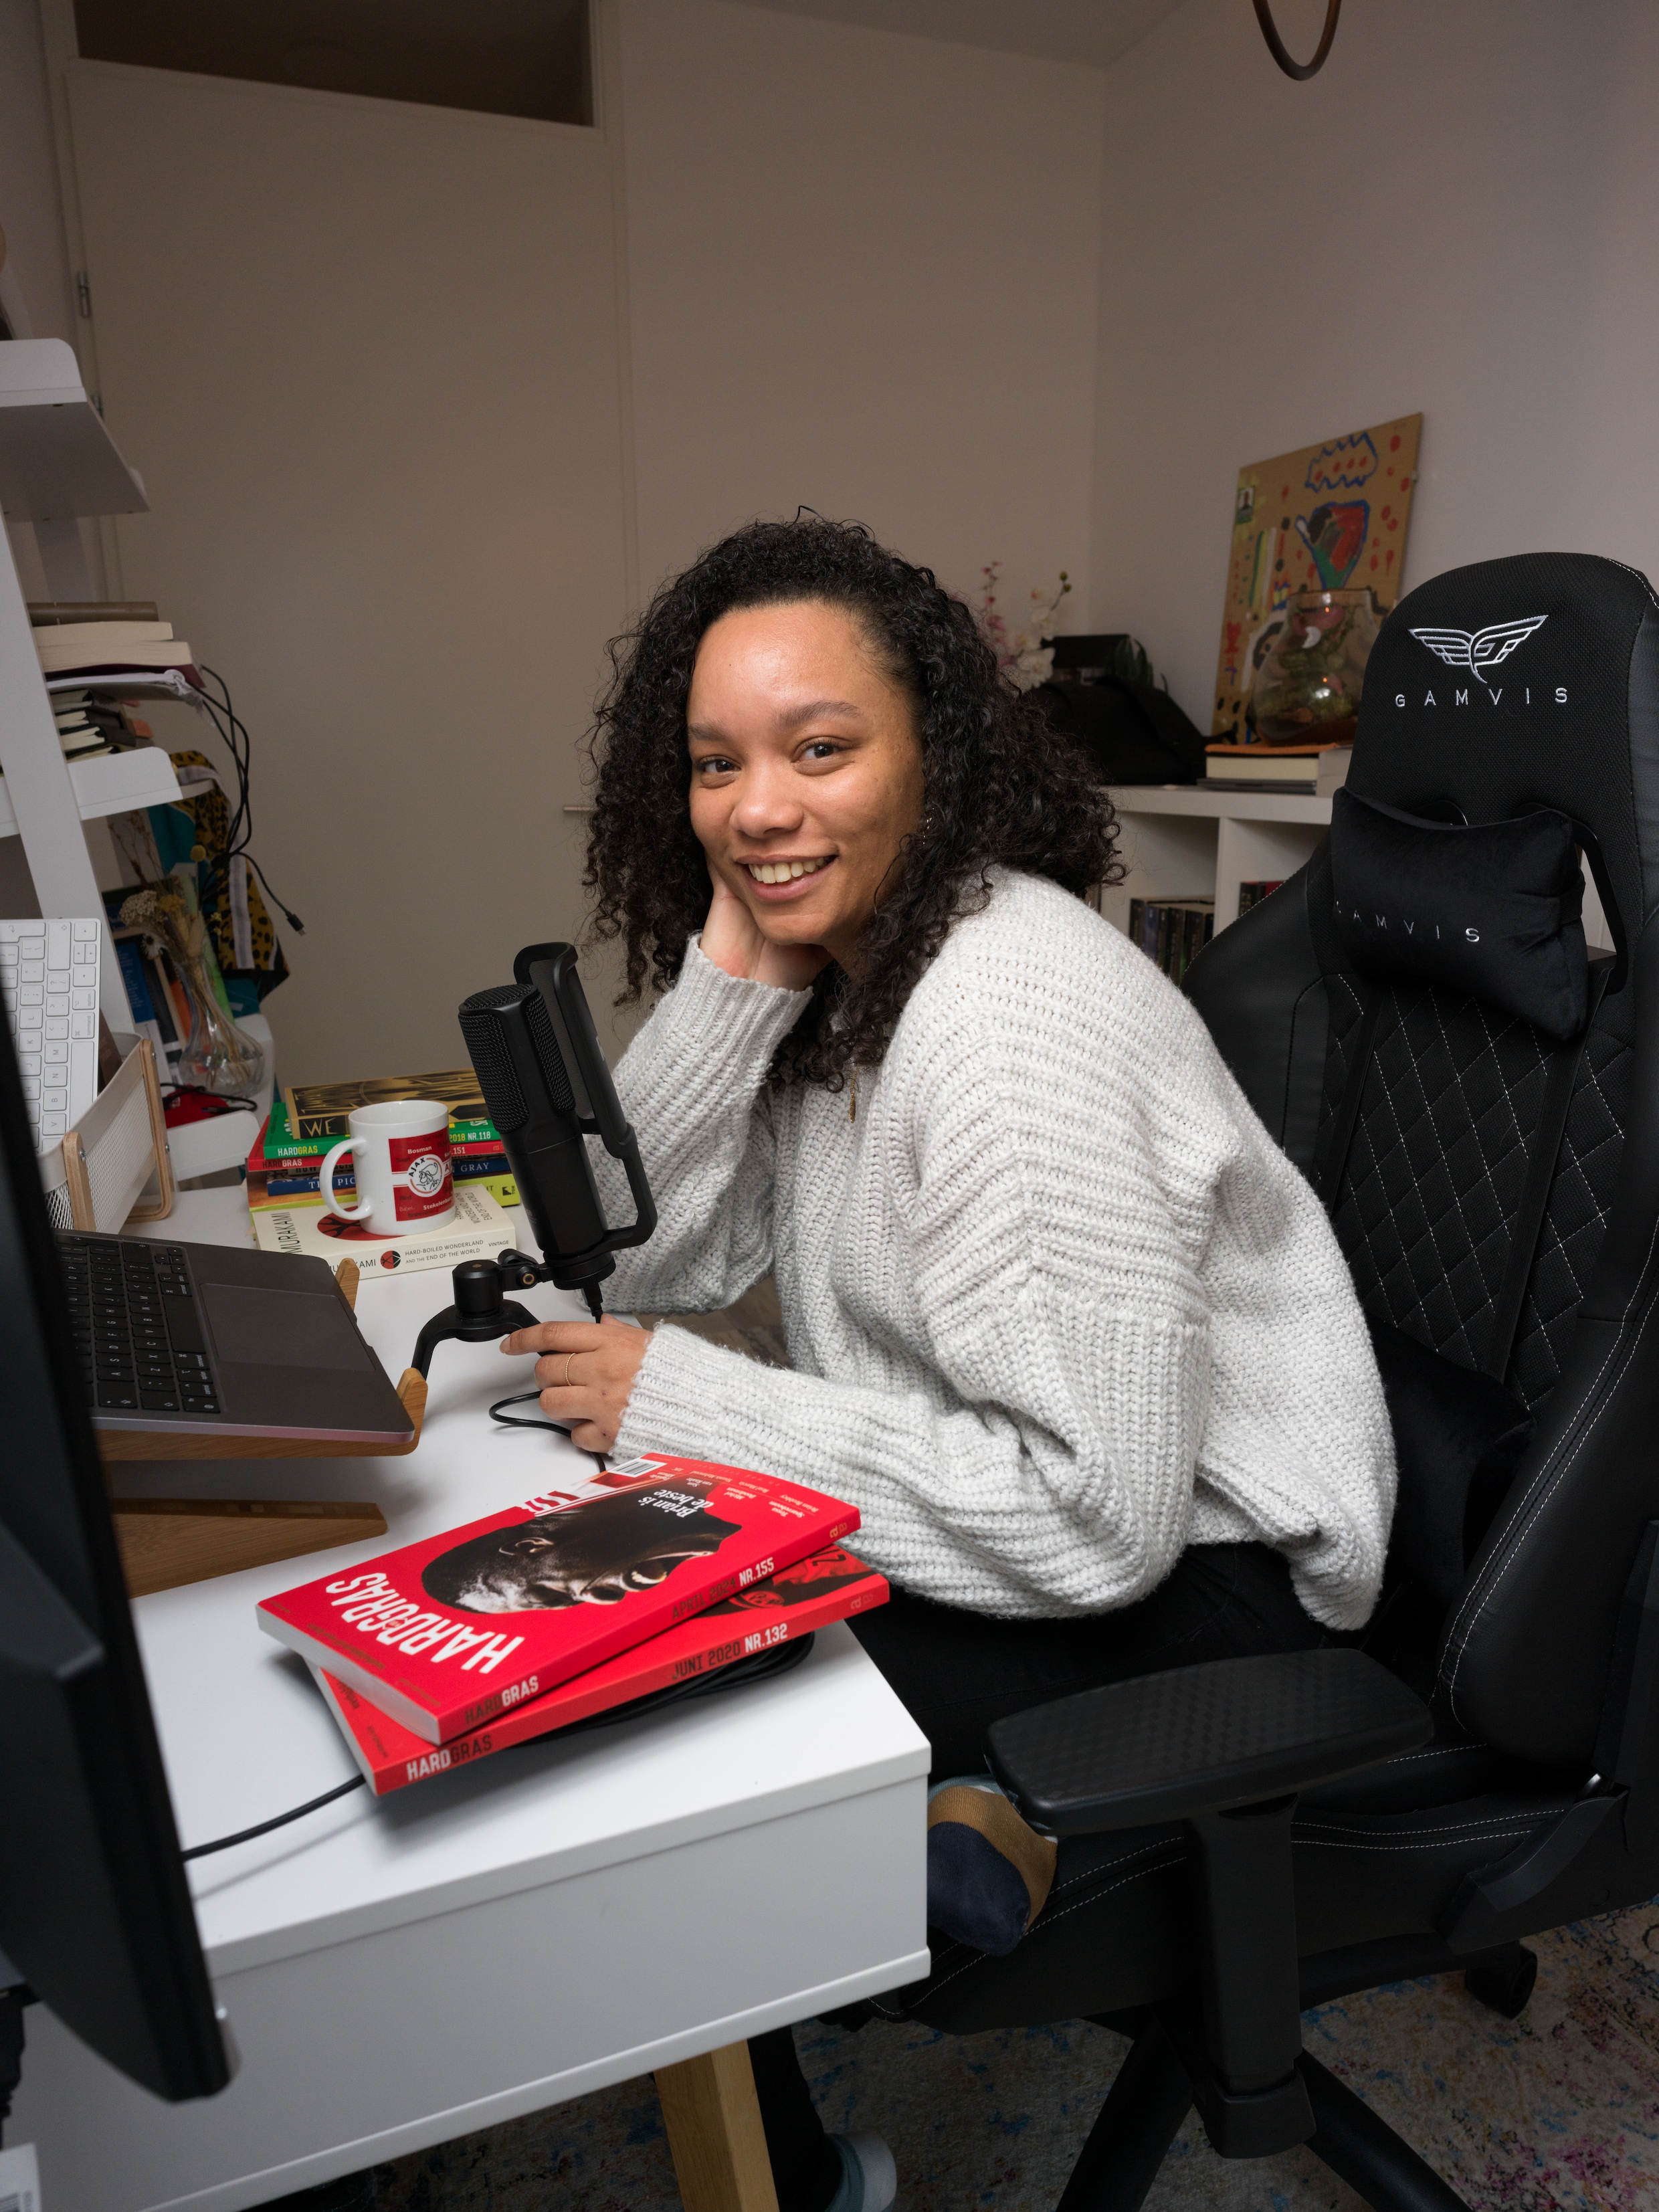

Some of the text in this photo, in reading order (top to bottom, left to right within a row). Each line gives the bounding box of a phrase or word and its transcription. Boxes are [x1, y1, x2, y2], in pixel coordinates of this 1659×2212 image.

[1395, 687, 1568, 708] GAMVIS
[1336, 900, 1480, 942] AMVIS
[303, 1116, 339, 1137] WE
[468, 1131, 491, 1140] NR.118
[278, 1144, 318, 1157] HARDGRAS
[407, 1146, 432, 1154] Bosman
[451, 1146, 466, 1154] .151
[262, 1159, 302, 1169] HARDGRAS
[409, 1157, 425, 1177] AJAX
[460, 1163, 489, 1172] GRAY
[405, 1239, 484, 1256] HARD-BOILED WONDERLAND
[460, 1247, 480, 1255] WORLD
[488, 1239, 510, 1247] VINTAGE
[638, 1496, 698, 1518] Brian is
[654, 1489, 714, 1510] de beste
[801, 1503, 819, 1513] Brian
[672, 1594, 707, 1621] APRIL
[709, 1577, 737, 1601] 2024
[739, 1556, 775, 1587] NR.155
[325, 1573, 525, 1674] HARDGRAS
[671, 1623, 788, 1680] JUNI 2020 NR.132
[464, 1676, 539, 1725] HARDGRAS
[405, 1734, 492, 1782] HARDGRAS
